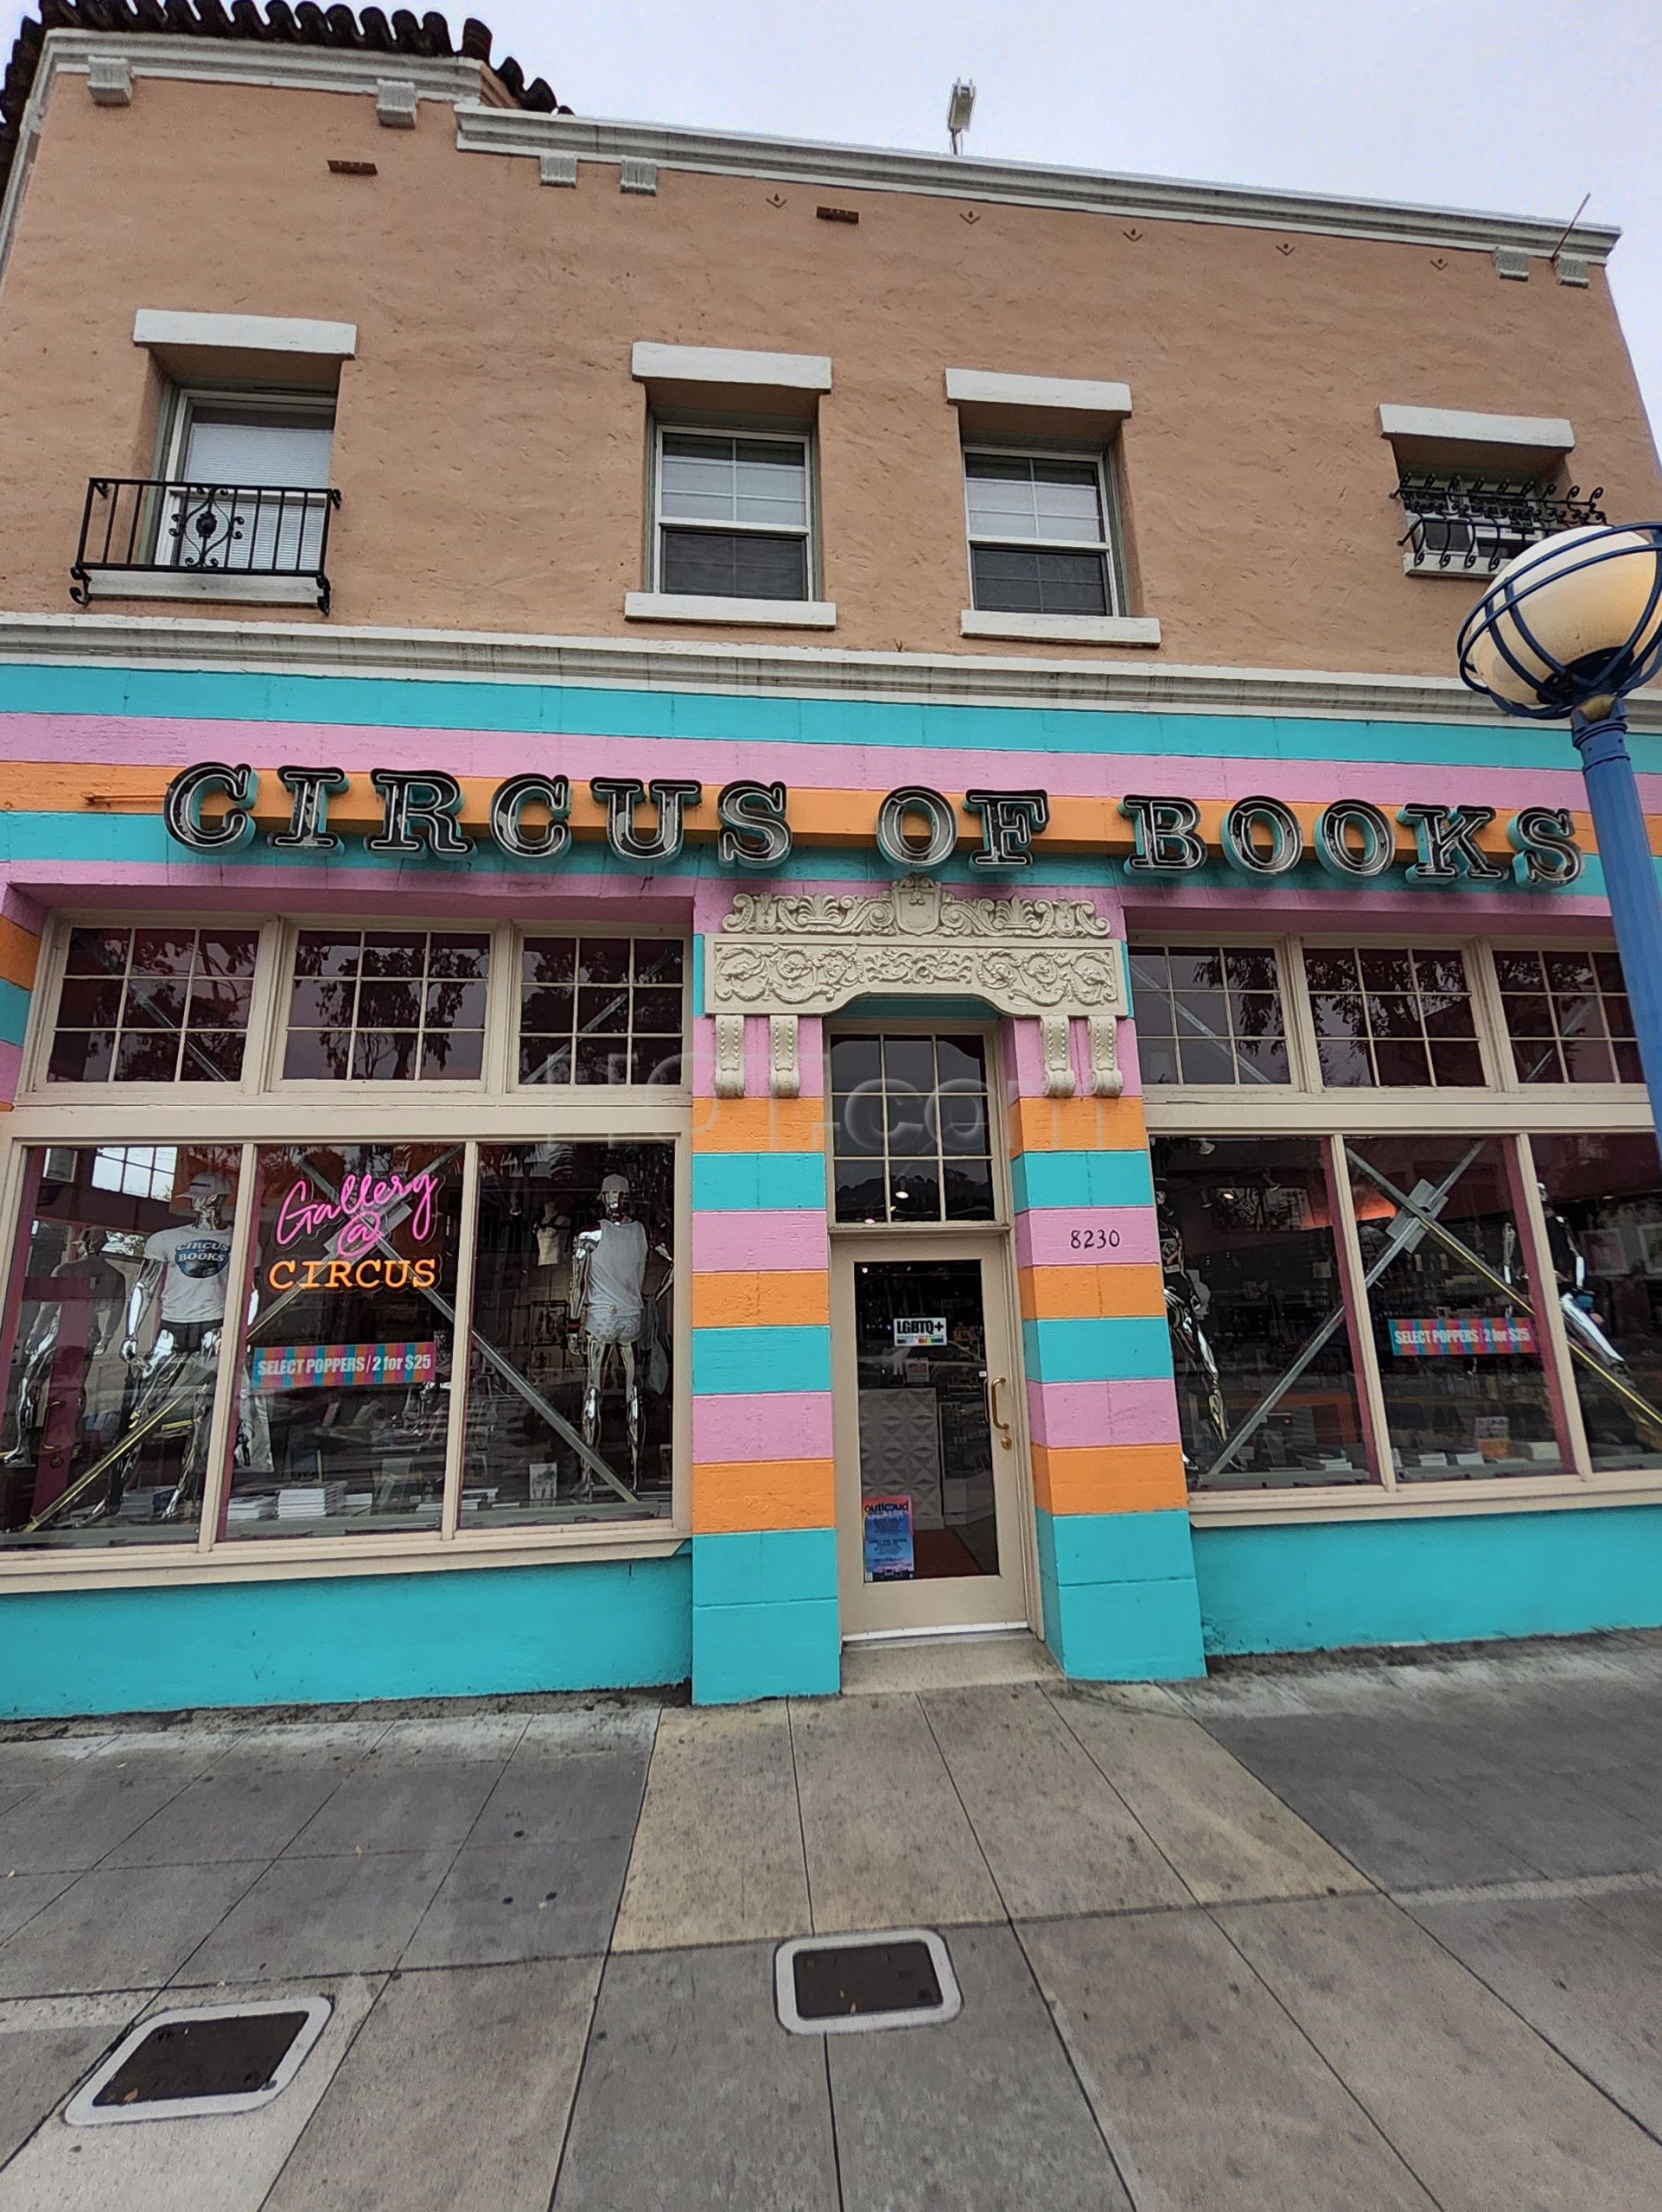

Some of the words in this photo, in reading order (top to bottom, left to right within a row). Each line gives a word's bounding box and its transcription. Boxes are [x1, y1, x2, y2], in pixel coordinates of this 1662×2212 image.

[164, 762, 792, 868] CIRCUS
[876, 785, 1050, 871] OF
[1118, 793, 1584, 888] BOOKS
[277, 1173, 438, 1244] Gallery
[338, 1211, 381, 1258] @
[1071, 1229, 1120, 1249] 8230
[176, 1242, 229, 1251] CIRCUS
[178, 1252, 226, 1262] BOOKS
[269, 1258, 436, 1289] CIRCUS
[896, 1320, 945, 1335] LGBTQ+
[1395, 1329, 1431, 1344] SELECT
[1431, 1328, 1480, 1344] POPPERS
[258, 1359, 305, 1376] SELECT
[305, 1357, 365, 1374] POPPERS
[372, 1355, 381, 1371] 2
[384, 1356, 403, 1370] for
[404, 1354, 431, 1371] $25
